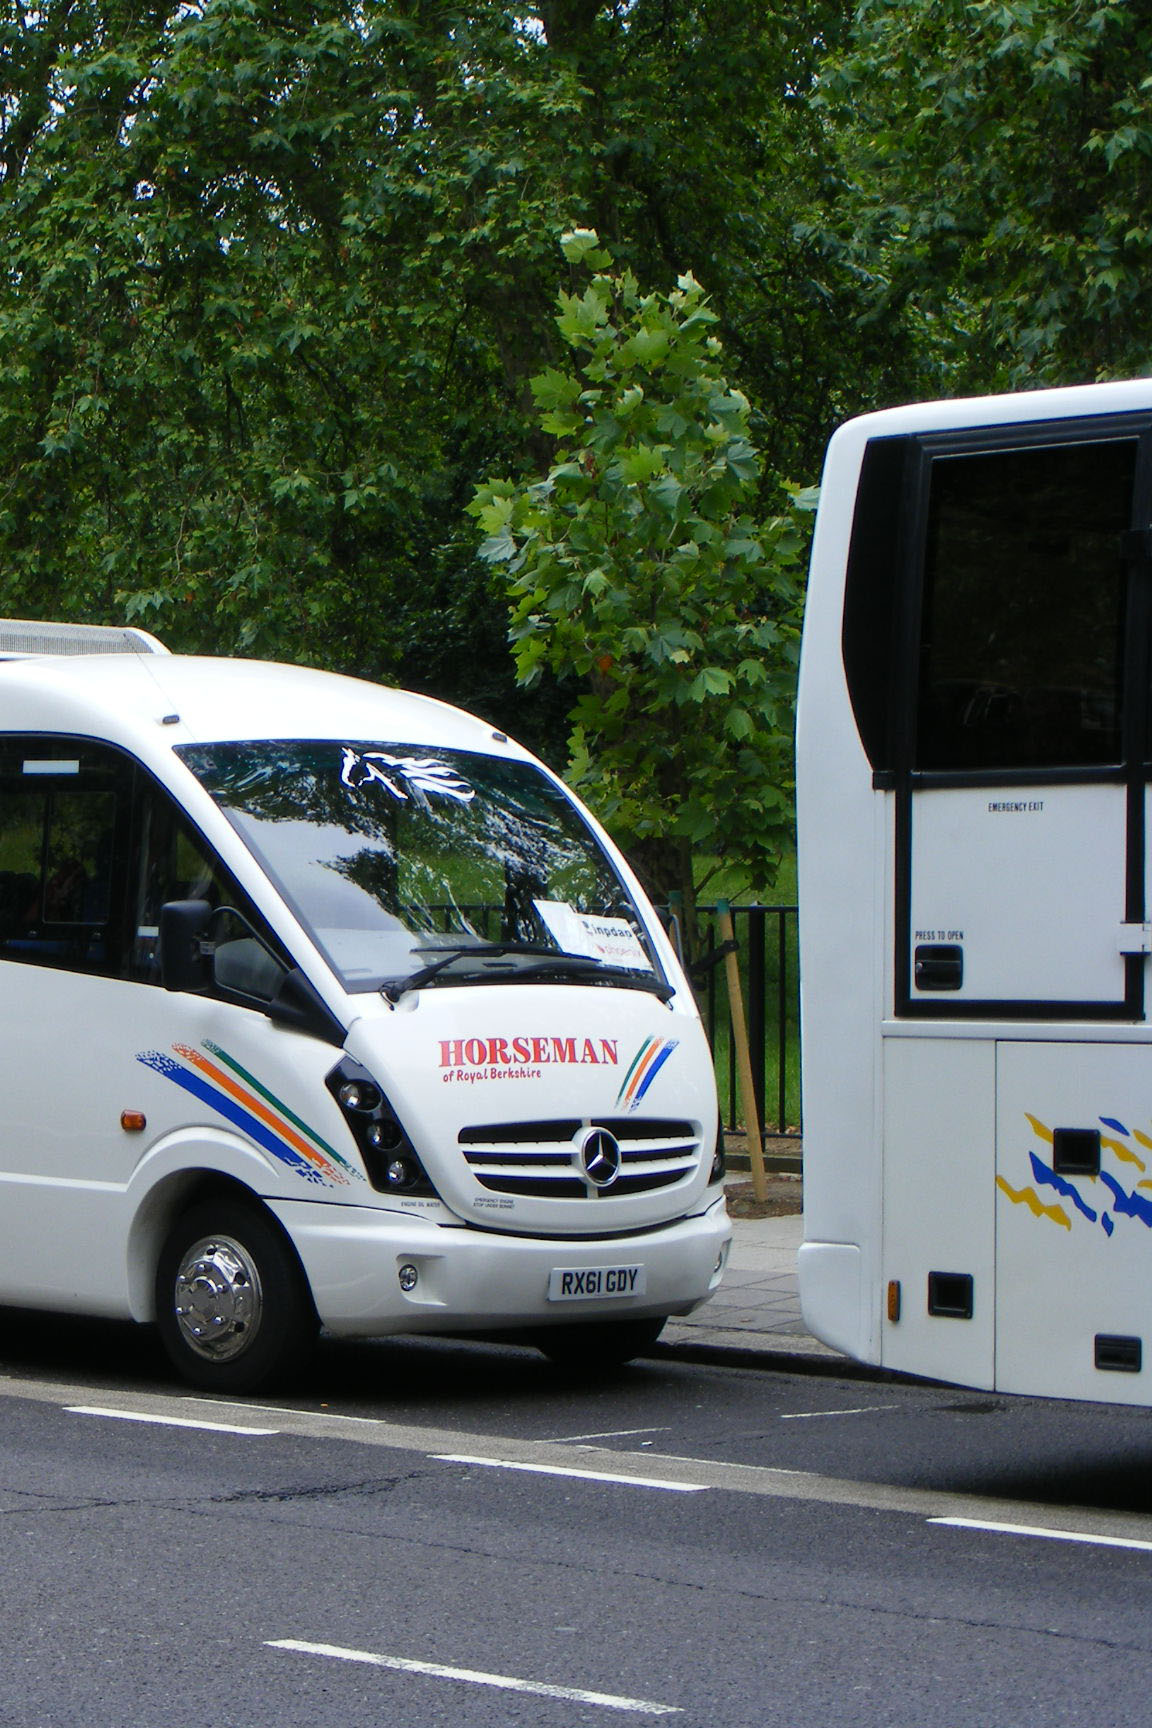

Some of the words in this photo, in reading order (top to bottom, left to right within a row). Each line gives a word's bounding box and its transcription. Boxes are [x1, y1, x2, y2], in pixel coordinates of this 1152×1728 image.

[988, 802, 1027, 812] EMERGENCY
[1028, 801, 1044, 811] EXIT
[915, 930, 935, 940] PRESS
[937, 930, 946, 940] TO
[947, 930, 964, 940] OPEN
[438, 1037, 618, 1067] HORSEMAN
[443, 1070, 455, 1083] of
[456, 1068, 488, 1084] Royal
[490, 1067, 542, 1079] Berkshire
[561, 1270, 602, 1295] RX61
[605, 1268, 638, 1292] GDY
